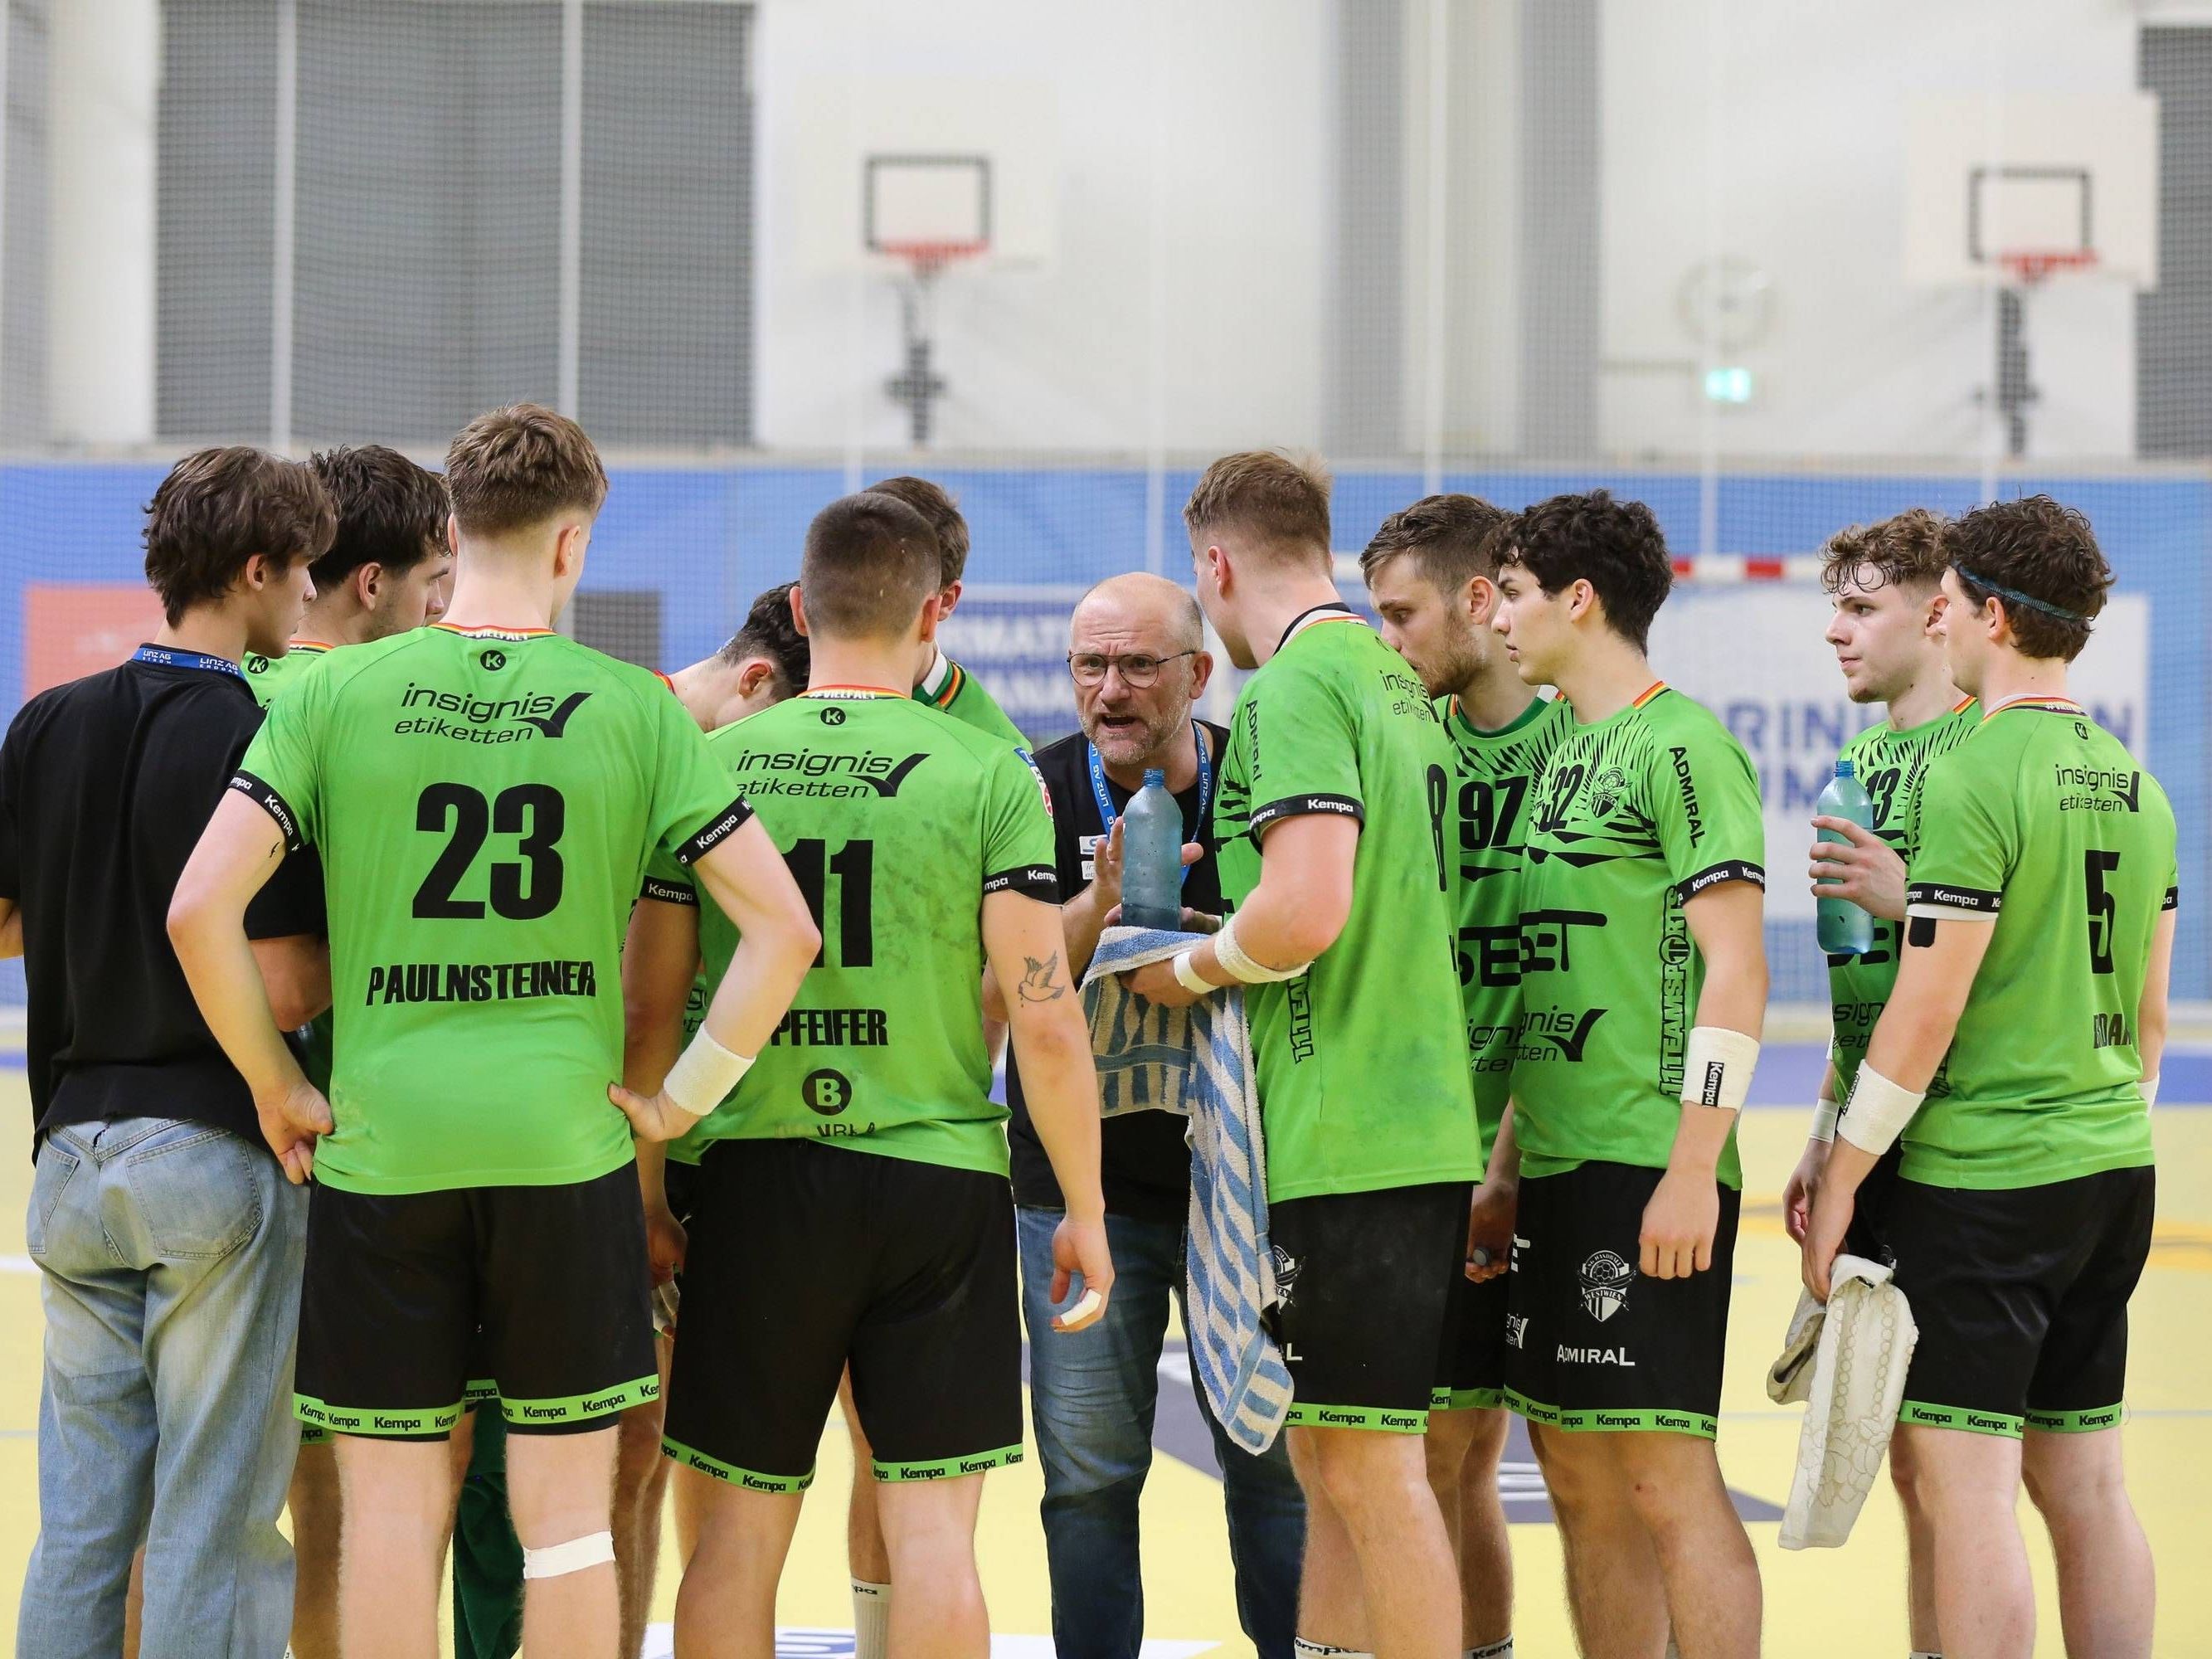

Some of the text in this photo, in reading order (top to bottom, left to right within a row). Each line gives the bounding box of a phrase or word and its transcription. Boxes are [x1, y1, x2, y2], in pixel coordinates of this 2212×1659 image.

[200, 657, 224, 666] LINZ
[401, 682, 556, 724] insignis
[395, 717, 533, 744] etiketten
[737, 748, 893, 777] insignis
[231, 777, 252, 791] mpa
[2055, 763, 2129, 792] insignis
[1307, 799, 1354, 813] Kempa
[1669, 747, 1707, 849] ADMIRAL
[265, 795, 294, 837] Kempa
[1250, 809, 1276, 826] mpa
[1458, 776, 1529, 850] 97
[697, 815, 738, 849] Kempa
[412, 782, 566, 921] 23
[984, 877, 1009, 890] mpa
[1692, 869, 1729, 892] Kempa
[649, 883, 693, 902] Kempa
[1933, 889, 1979, 907] Kempa
[781, 839, 873, 968] 11
[2085, 849, 2121, 974] 5
[366, 961, 596, 1006] PAULNSTEINER
[771, 1009, 889, 1047] PFEIFER
[1703, 1062, 1723, 1107] Kempa
[1556, 1343, 1636, 1366] ADMIRAL
[300, 1403, 326, 1422] Kempa
[523, 1406, 567, 1419] Kempa
[582, 1394, 626, 1413] Kempa
[1526, 1402, 1558, 1421] Kempa
[328, 1413, 360, 1429] Kempa
[374, 1416, 421, 1431] Kempa
[1319, 1410, 1366, 1425] Kempa
[1381, 1413, 1417, 1429] Kempa
[1597, 1413, 1641, 1428] Kempa
[1655, 1414, 1690, 1429] Kempa
[1912, 1408, 1952, 1424] Kempa
[1967, 1414, 2007, 1431] Kempa
[2024, 1412, 2064, 1429] Kempa
[2079, 1413, 2114, 1426] Kempa
[689, 1453, 729, 1481] Kempa
[960, 1458, 996, 1473] Kempa
[1005, 1452, 1023, 1465] Kem
[901, 1467, 946, 1480] Kempa
[742, 1474, 786, 1493] Kempa
